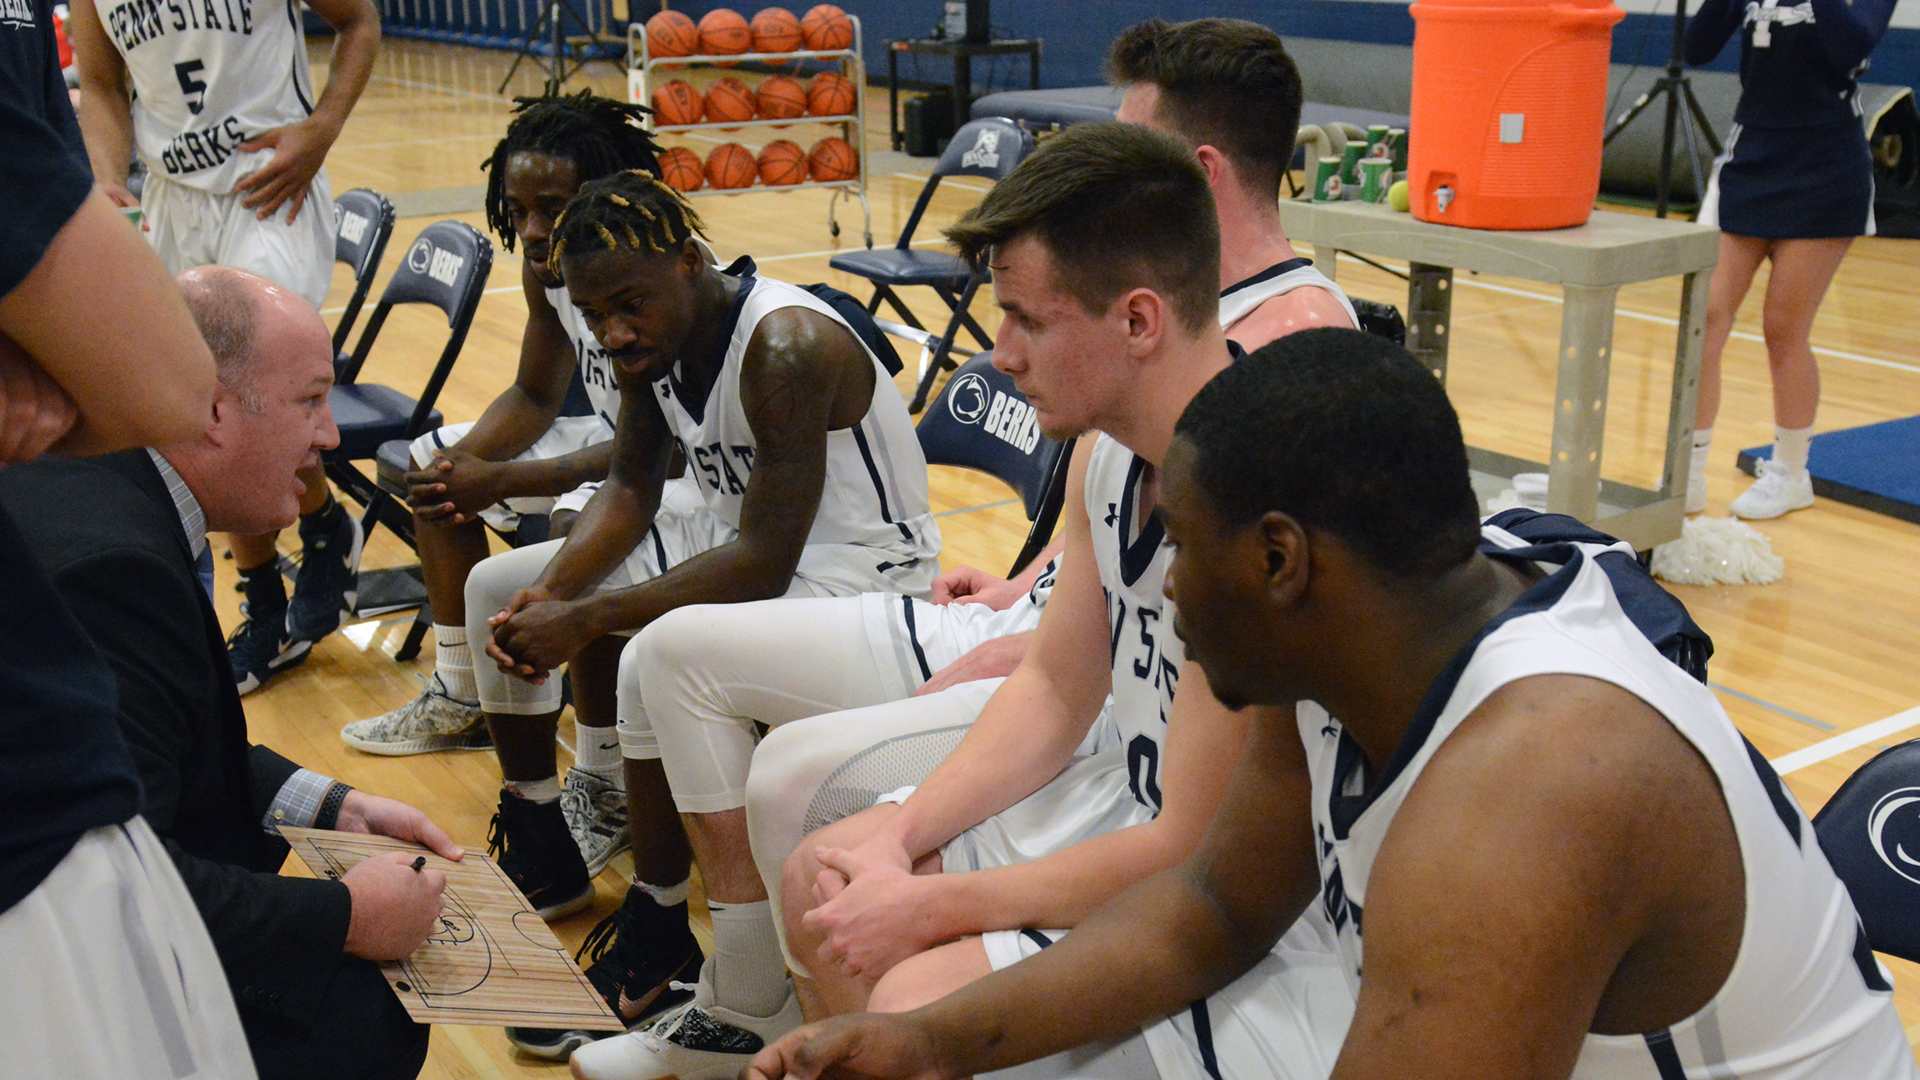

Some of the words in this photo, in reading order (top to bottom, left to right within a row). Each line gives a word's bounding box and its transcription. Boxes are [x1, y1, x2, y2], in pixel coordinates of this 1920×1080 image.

[109, 0, 165, 51] PENN
[167, 0, 253, 35] STATE
[174, 59, 207, 115] 5
[162, 115, 246, 174] BERKS
[339, 210, 369, 246] BERKS
[428, 247, 464, 287] BERKS
[983, 390, 1041, 455] BERKS
